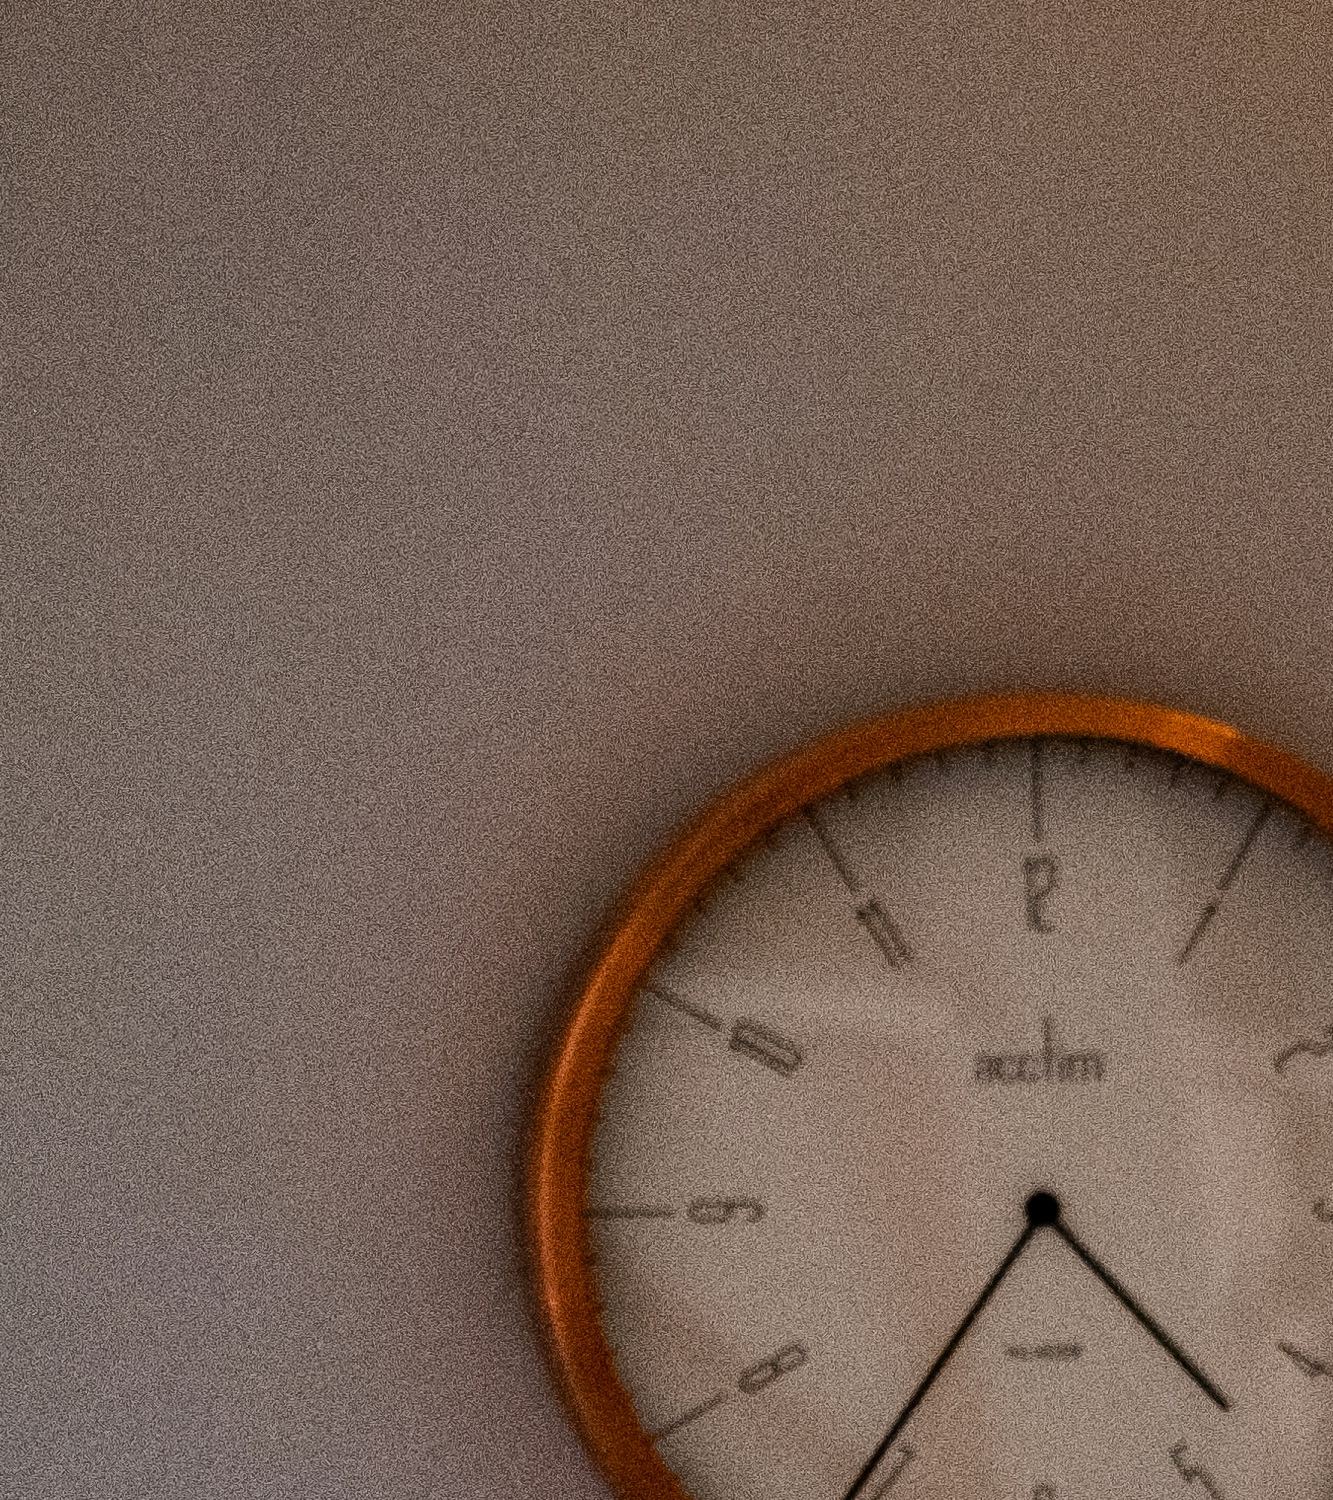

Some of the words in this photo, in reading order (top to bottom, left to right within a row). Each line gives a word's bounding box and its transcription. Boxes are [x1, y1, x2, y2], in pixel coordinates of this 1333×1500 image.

[1022, 854, 1058, 932] 12
[686, 1197, 764, 1223] 9
[737, 1342, 807, 1395] 8
